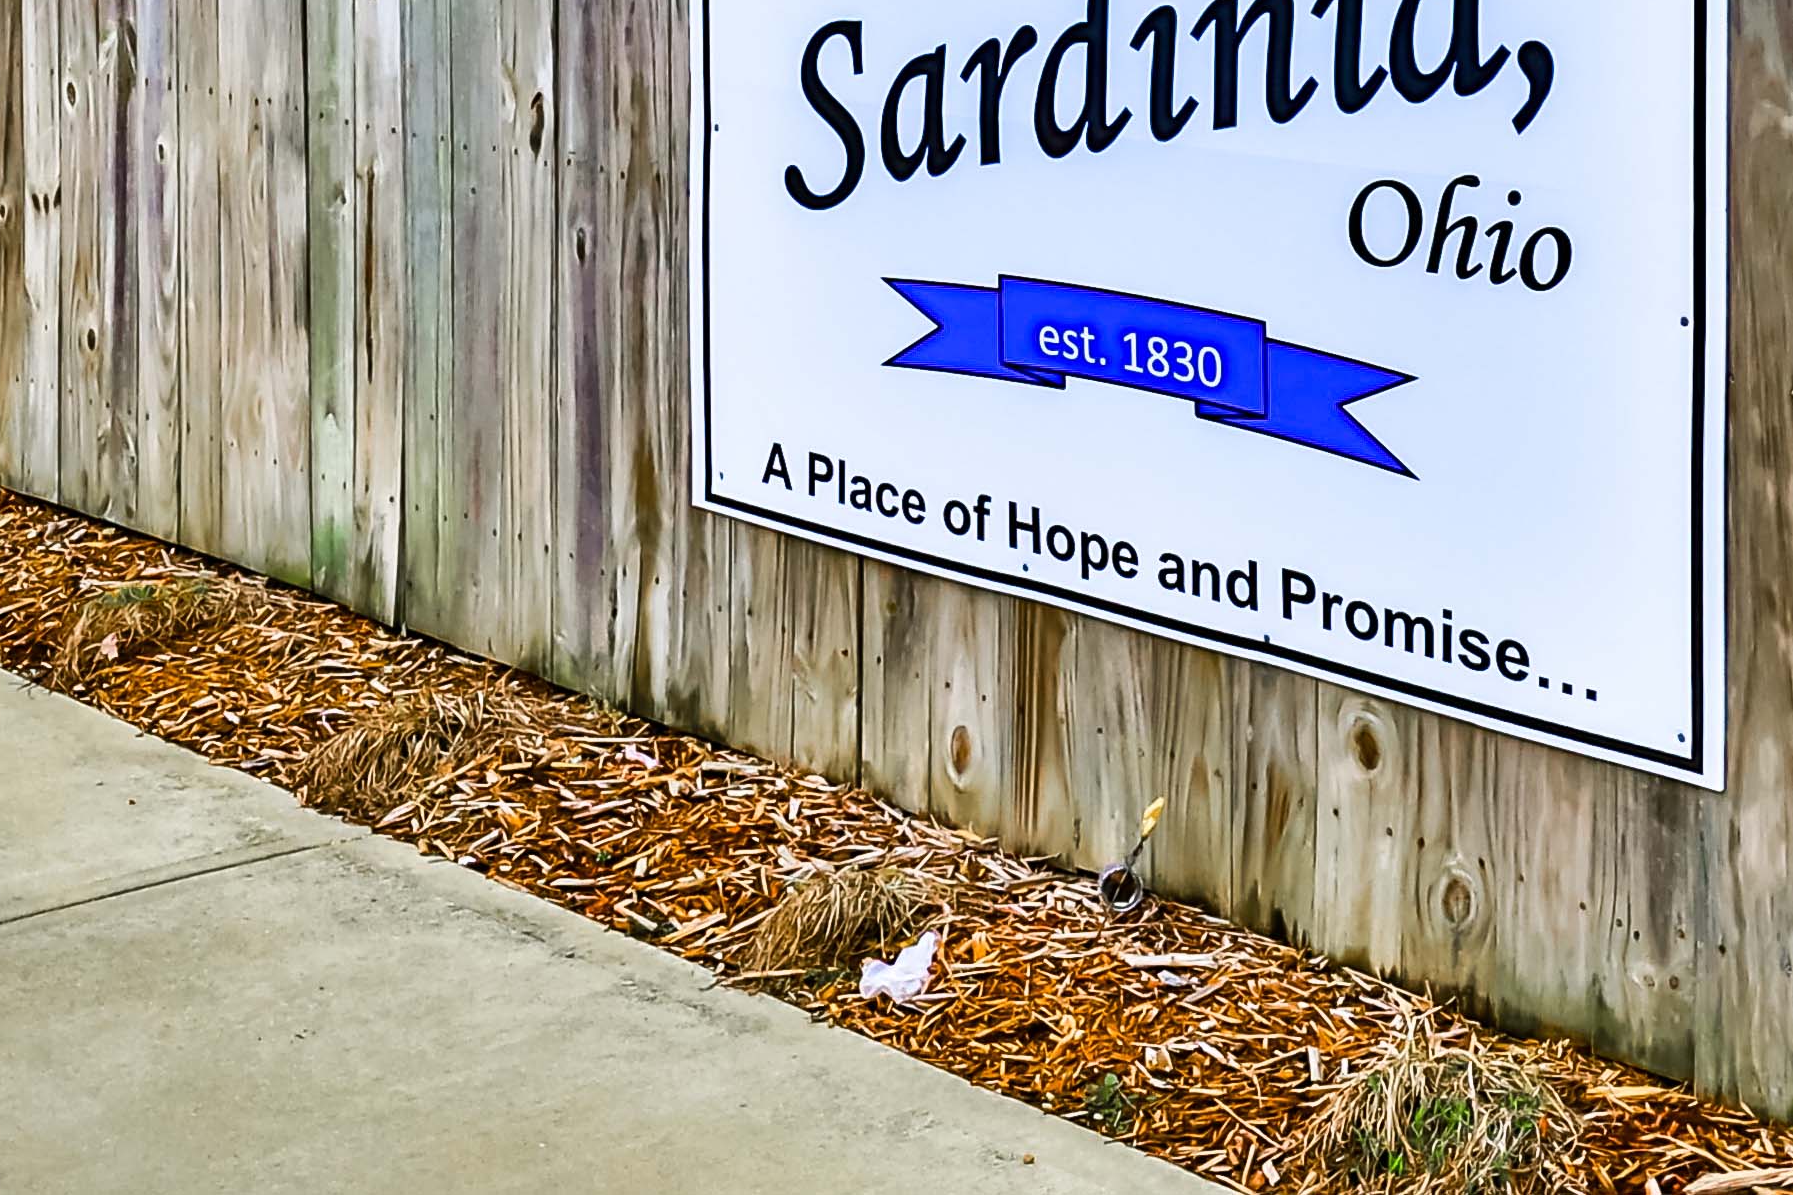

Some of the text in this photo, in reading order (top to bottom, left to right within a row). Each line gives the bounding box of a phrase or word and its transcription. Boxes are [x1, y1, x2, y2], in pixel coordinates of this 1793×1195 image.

[1347, 174, 1573, 292] Ohio
[1038, 325, 1223, 388] est. 1830
[761, 442, 1597, 702] A Place of Hope and Promise...
